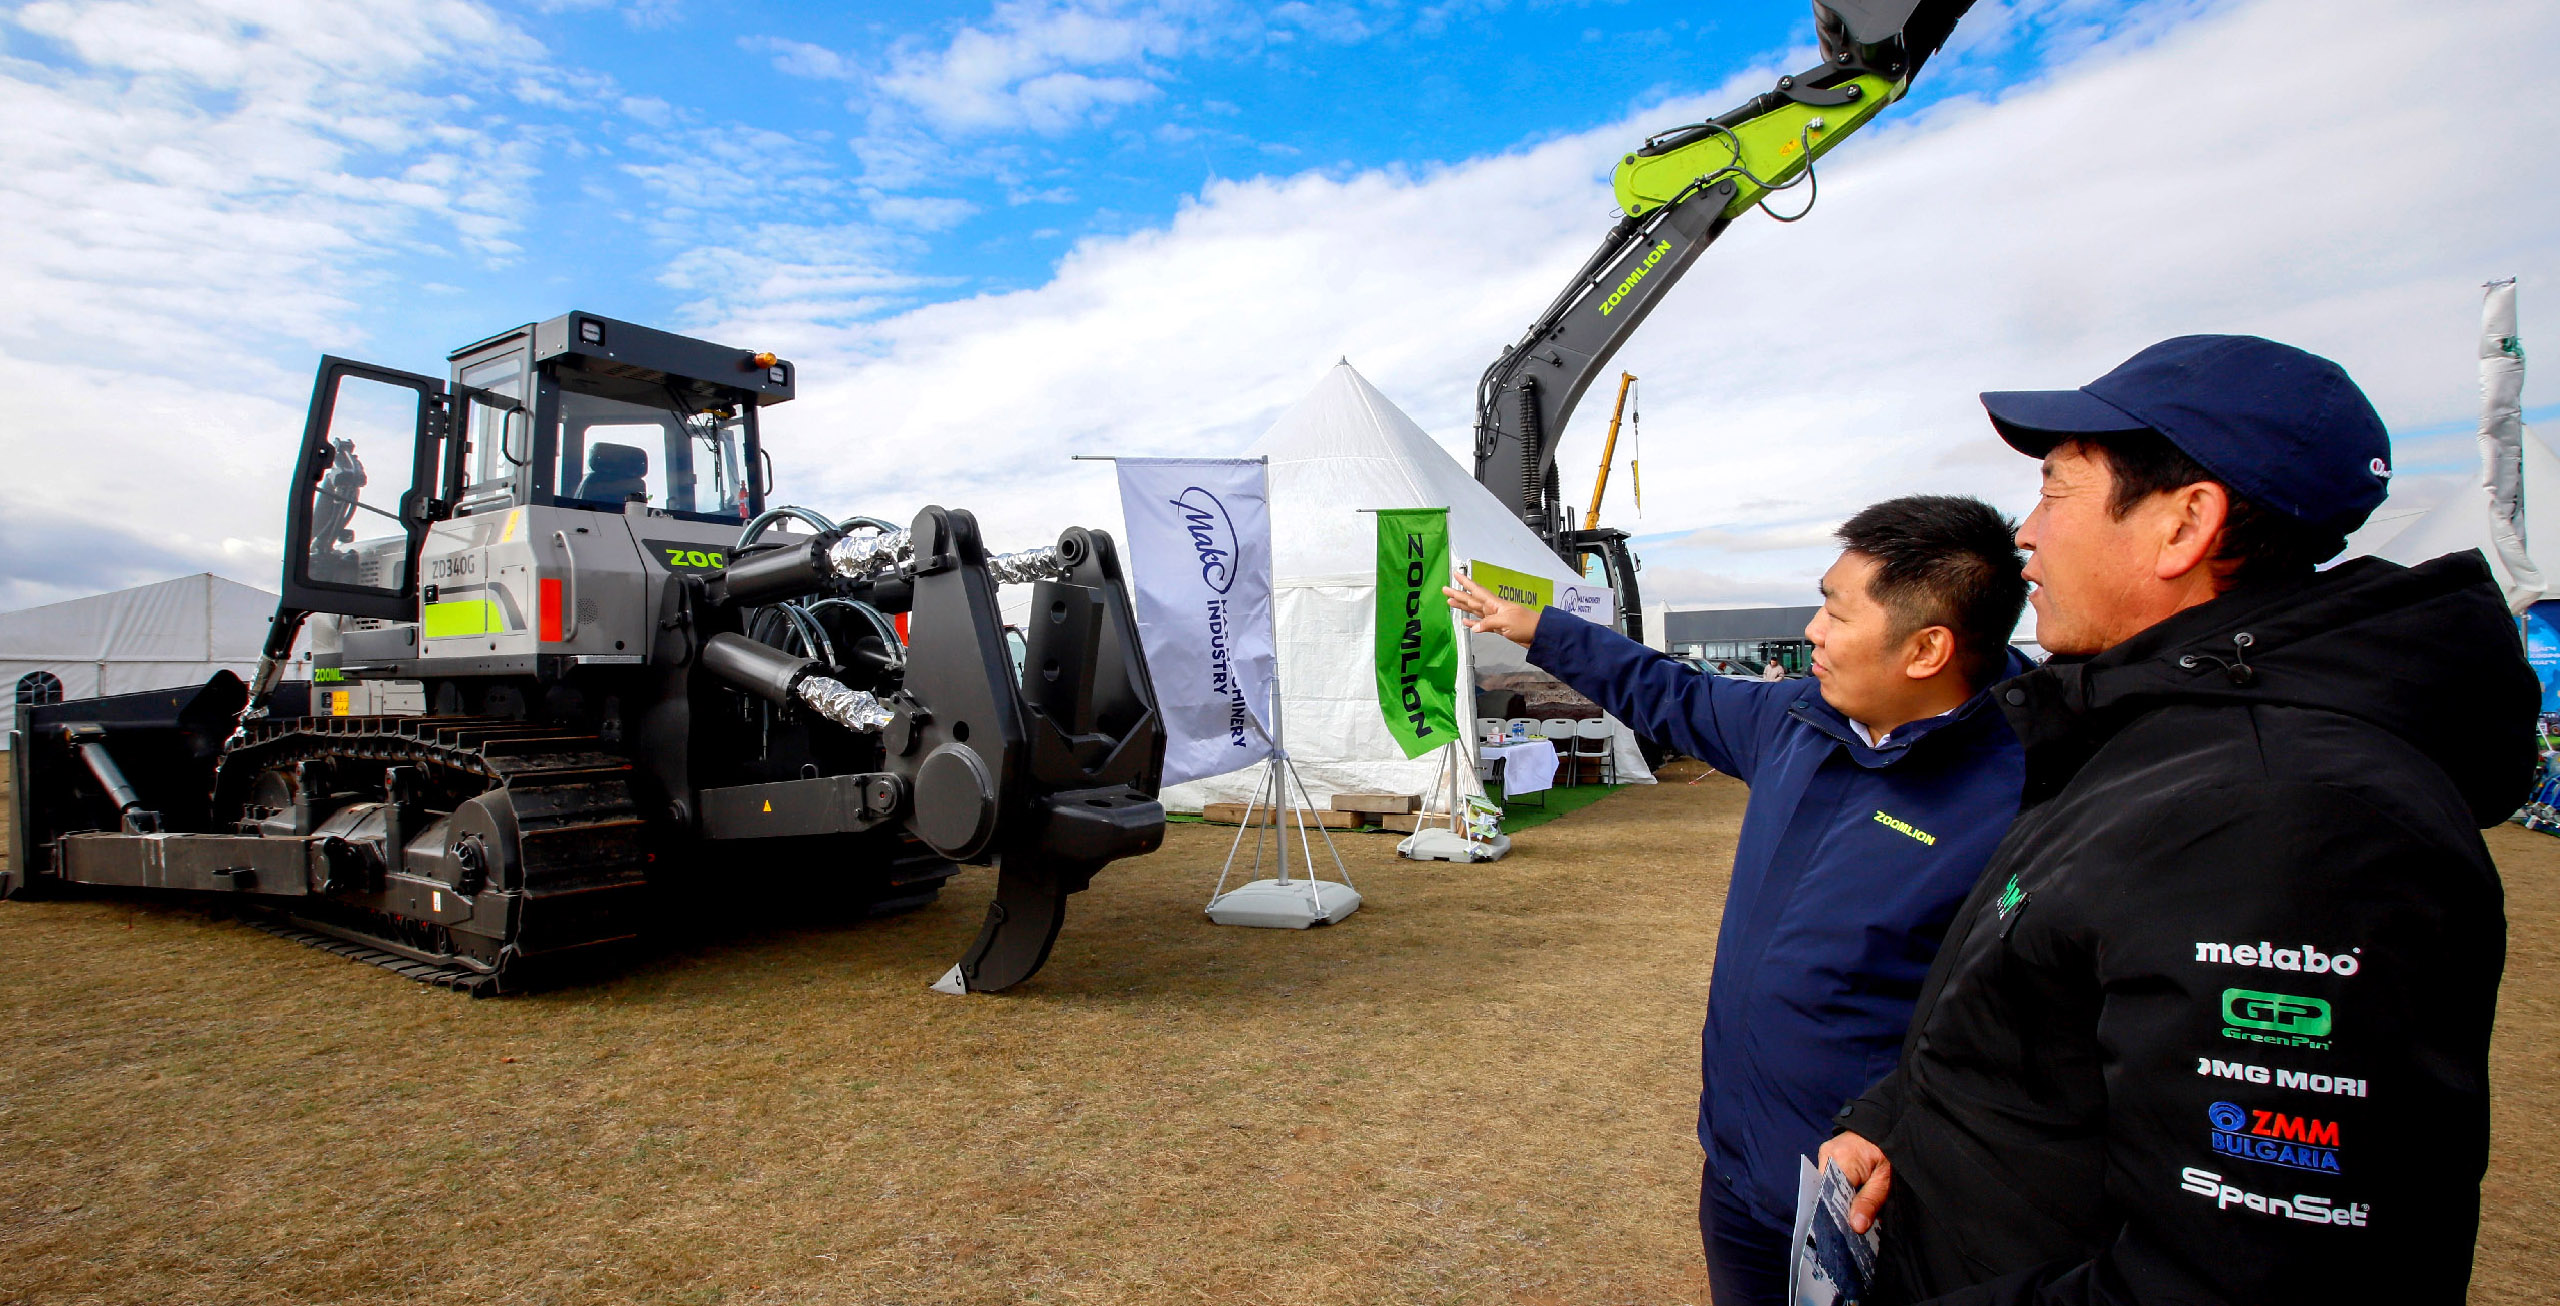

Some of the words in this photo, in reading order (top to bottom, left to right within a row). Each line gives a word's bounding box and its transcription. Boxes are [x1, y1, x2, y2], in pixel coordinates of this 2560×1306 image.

[1599, 240, 1672, 316] ZOOMLION
[432, 554, 475, 580] ZD340G
[1498, 585, 1537, 606] ZOOMLION
[1207, 600, 1229, 696] INDUSTRY
[1401, 534, 1433, 738] ZOOMLION
[315, 668, 345, 682] ZOOML
[1874, 810, 1936, 846] ZOOMLION
[2196, 941, 2359, 976] metabo
[2228, 994, 2326, 1029] GP
[2276, 1069, 2367, 1097] MORI
[2251, 1109, 2340, 1146] ZMM
[2212, 1131, 2340, 1171] BULGARIA
